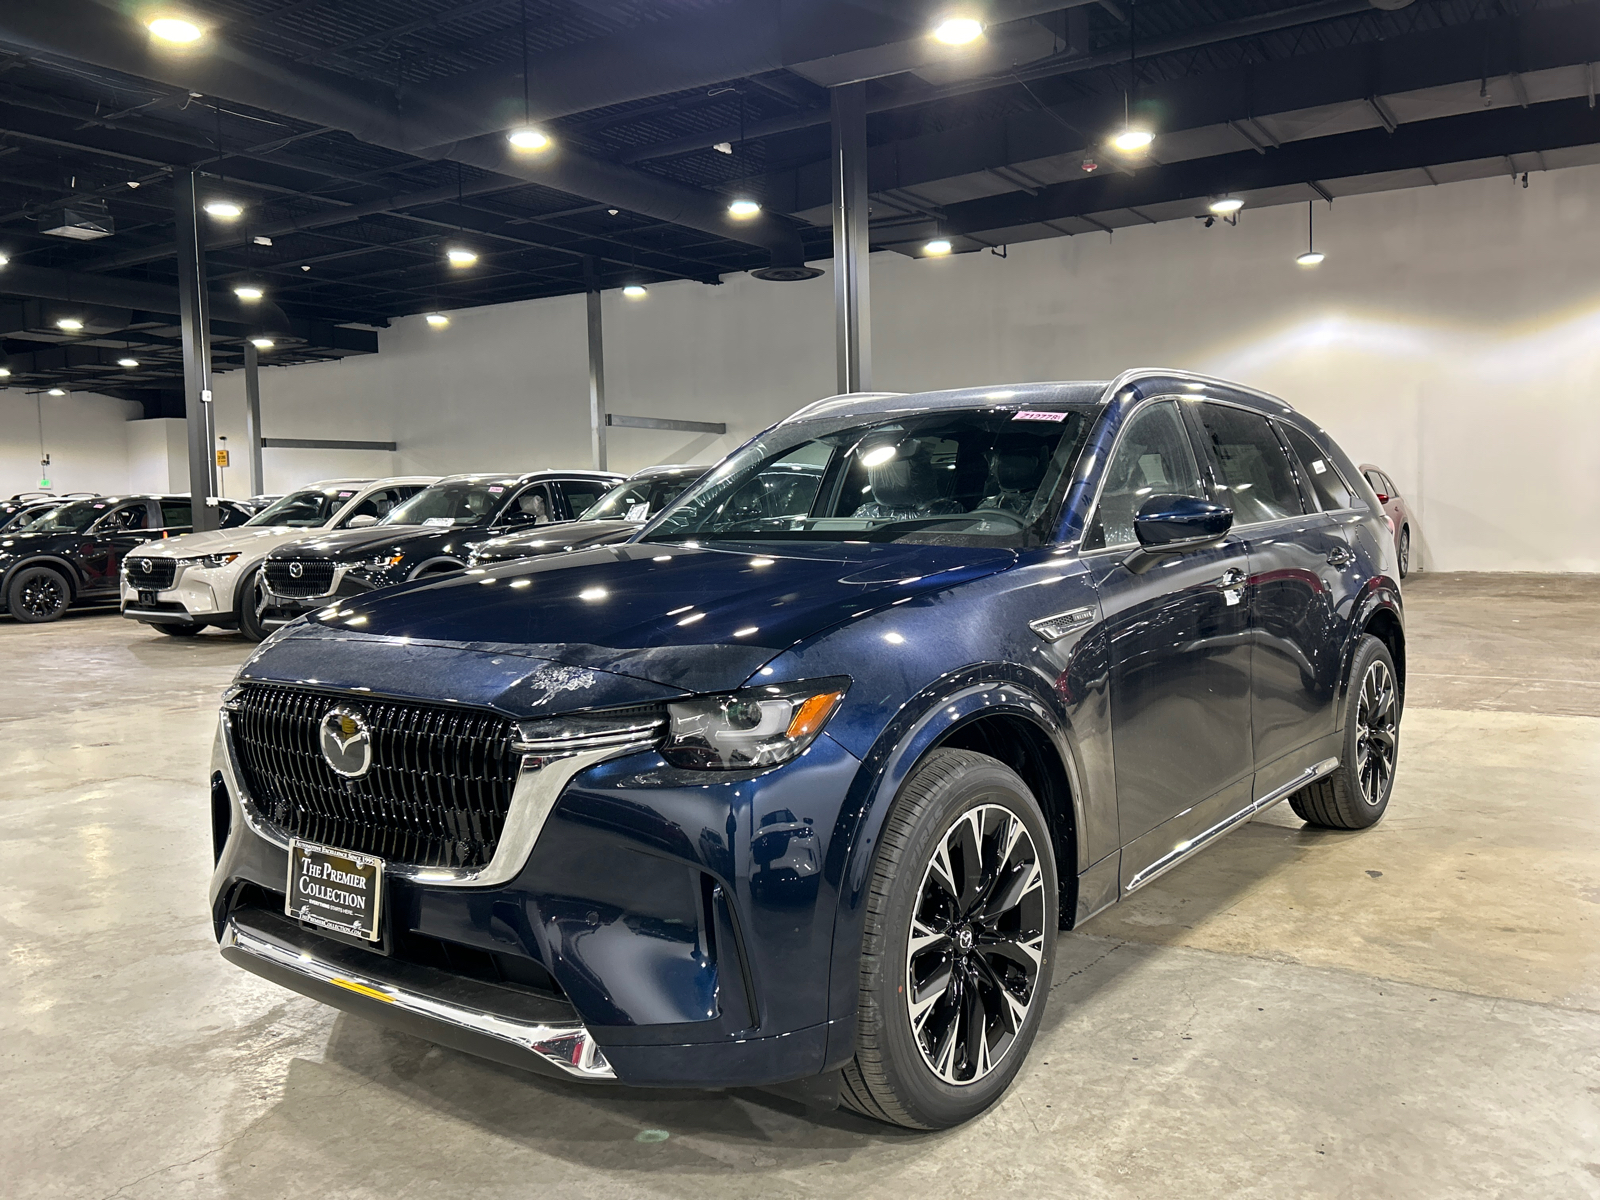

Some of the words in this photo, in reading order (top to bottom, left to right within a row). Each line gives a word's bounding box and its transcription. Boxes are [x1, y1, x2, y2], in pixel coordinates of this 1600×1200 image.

[301, 857, 322, 878] THE
[322, 862, 367, 889] PREMIER
[299, 876, 366, 909] COLLECTION
